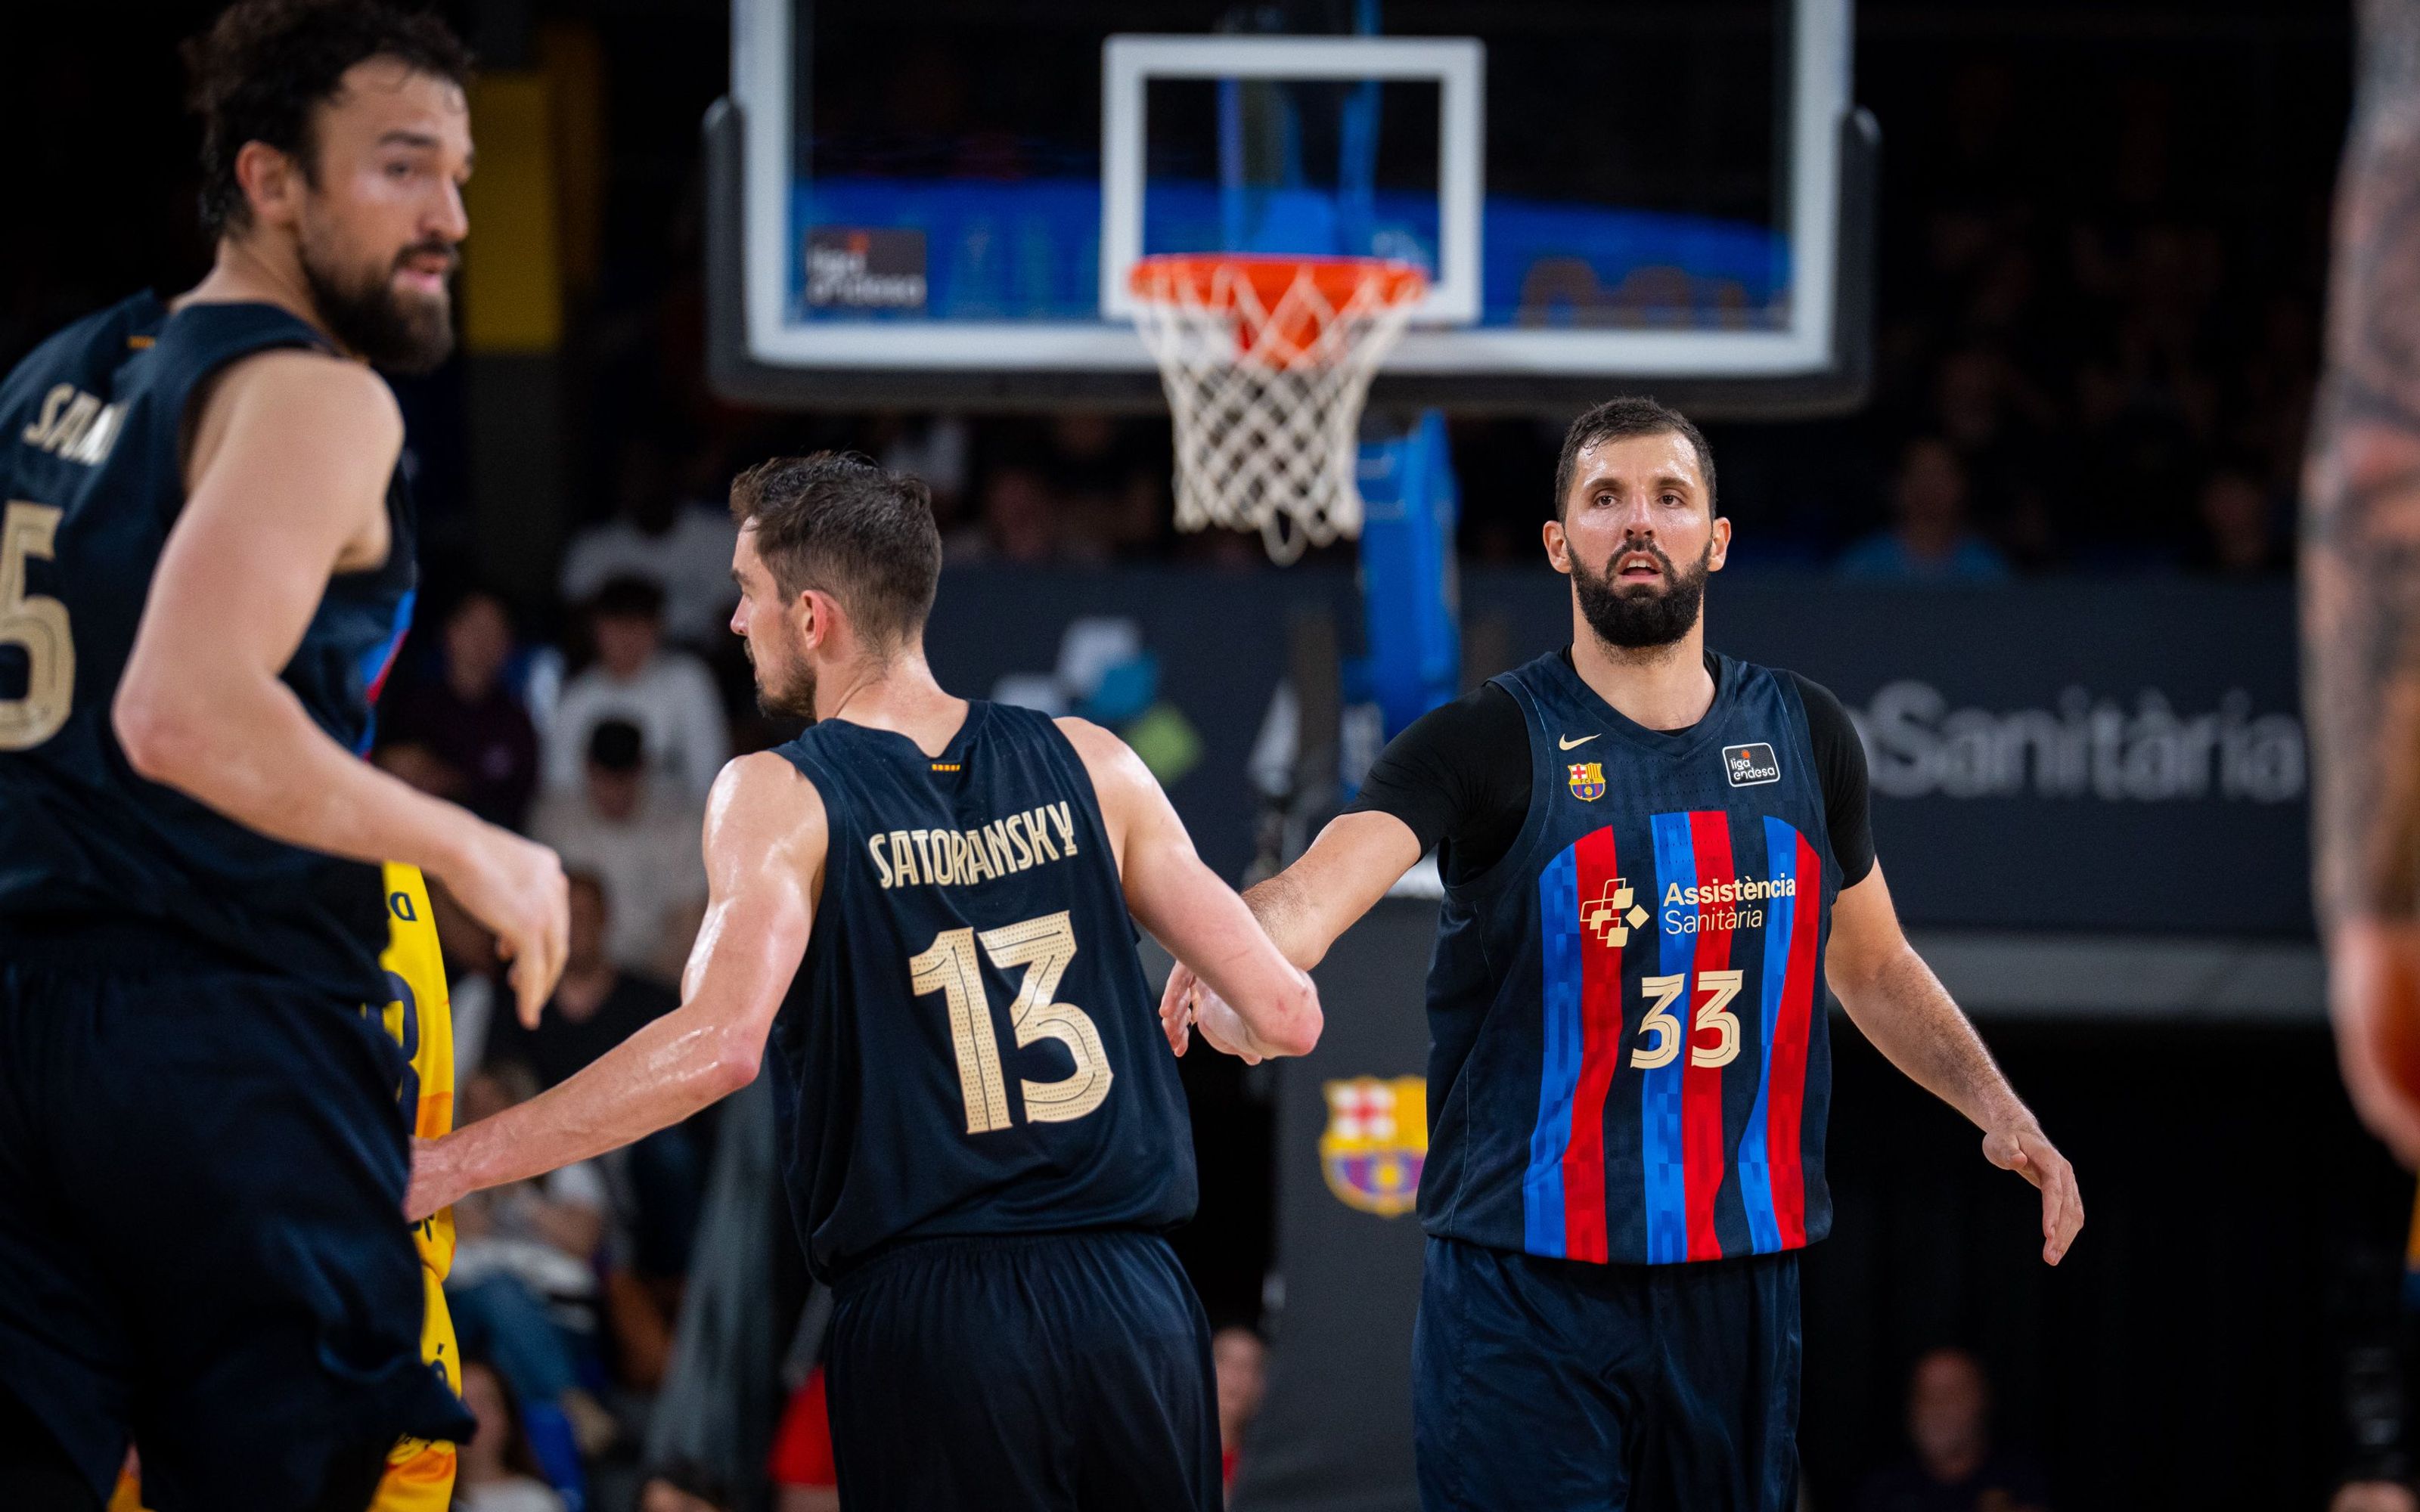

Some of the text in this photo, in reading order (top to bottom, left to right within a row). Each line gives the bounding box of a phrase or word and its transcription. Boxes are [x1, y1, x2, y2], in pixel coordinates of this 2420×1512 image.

[1730, 758, 1751, 770] liga
[1733, 767, 1776, 780] endesa
[868, 801, 1078, 890] SATORANSKY
[1663, 872, 1796, 906] Assistència
[1665, 904, 1763, 934] Sanitària
[909, 909, 1115, 1135] 13
[1630, 969, 1744, 1069] 33
